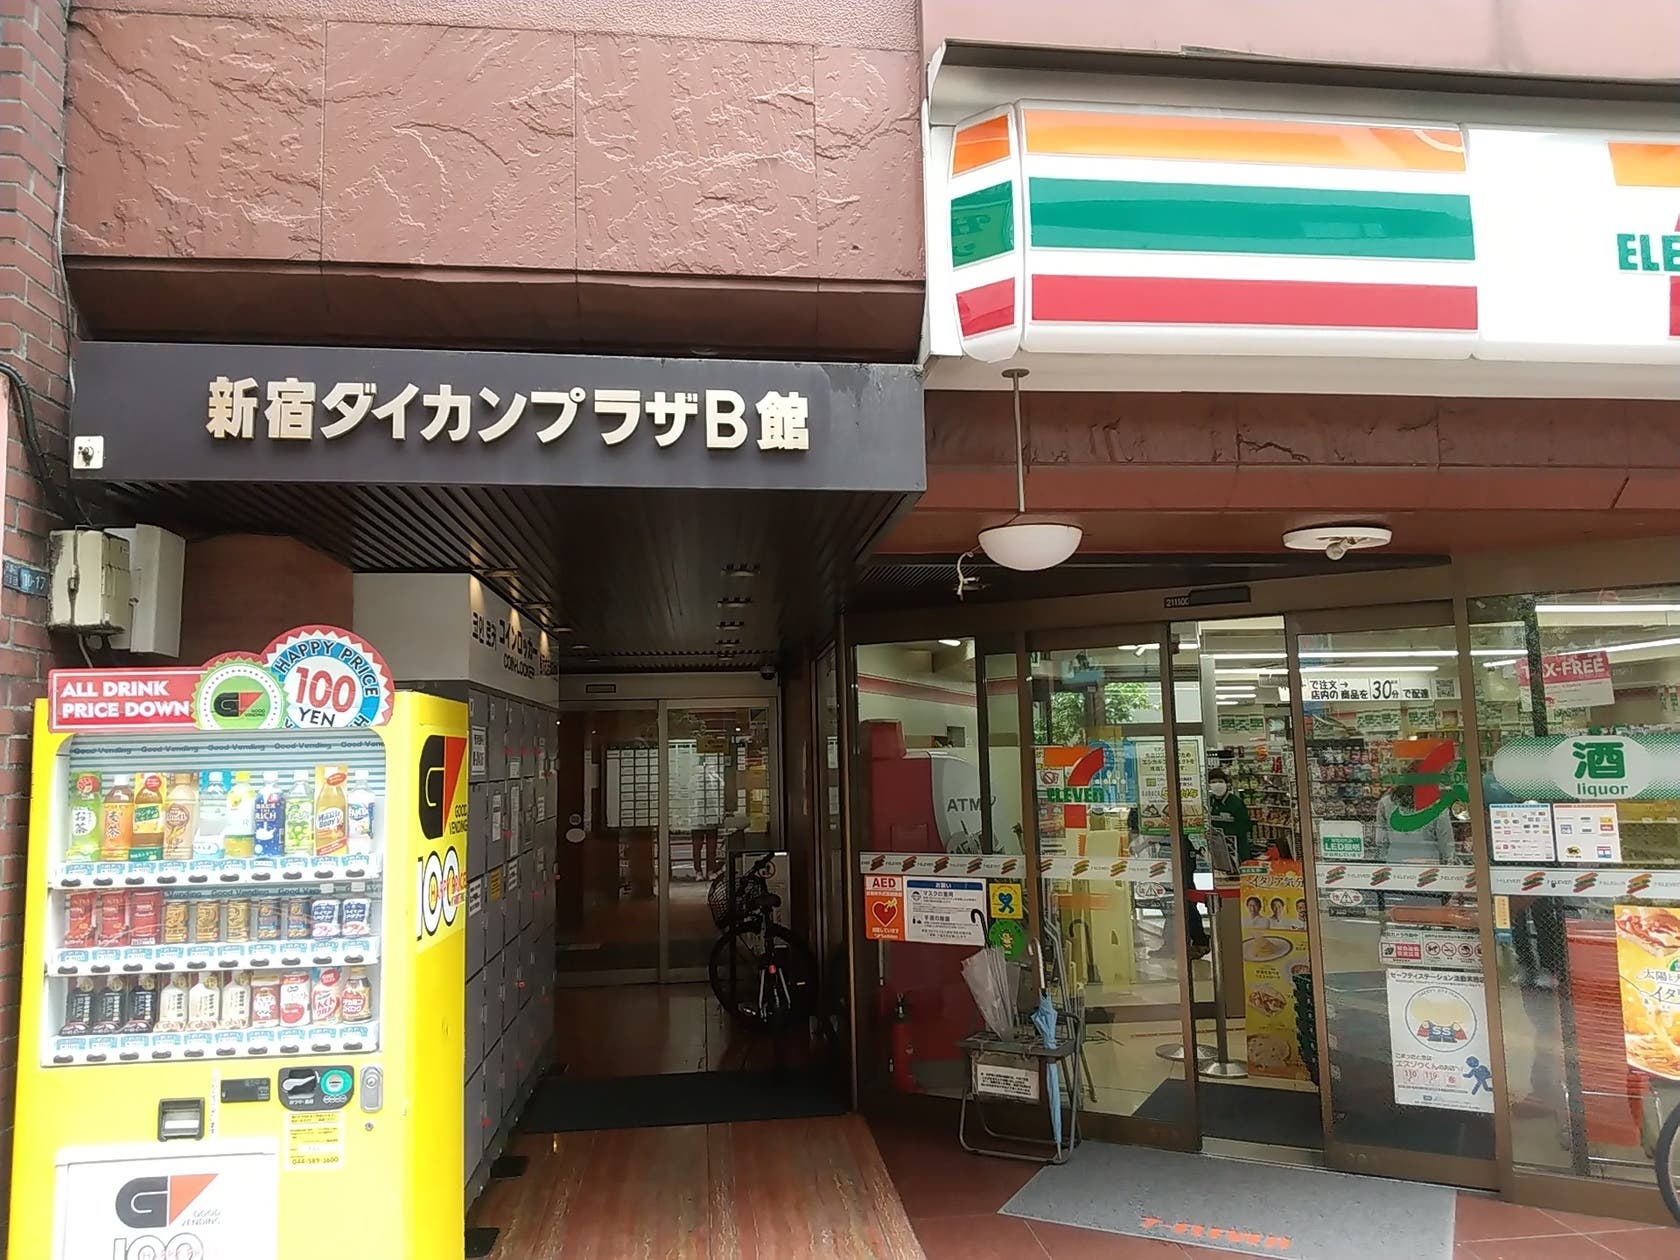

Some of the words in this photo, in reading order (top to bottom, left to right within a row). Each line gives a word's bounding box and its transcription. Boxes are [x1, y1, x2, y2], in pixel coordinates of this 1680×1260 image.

[205, 376, 810, 450] 新宿ダイカンプラザB館
[275, 640, 335, 674] HAPPY
[340, 647, 379, 697] PRICE
[1520, 657, 1606, 679] TX-FREE
[60, 680, 98, 698] ALL
[102, 679, 169, 697] DRINK
[296, 666, 356, 713] 100
[62, 703, 118, 719] PRICE
[125, 701, 190, 718] DOWN
[299, 707, 335, 727] YEN
[1572, 741, 1626, 779] 酒
[1577, 783, 1628, 797] liquor
[872, 877, 896, 889] AED
[1432, 1027, 1451, 1036] SS
